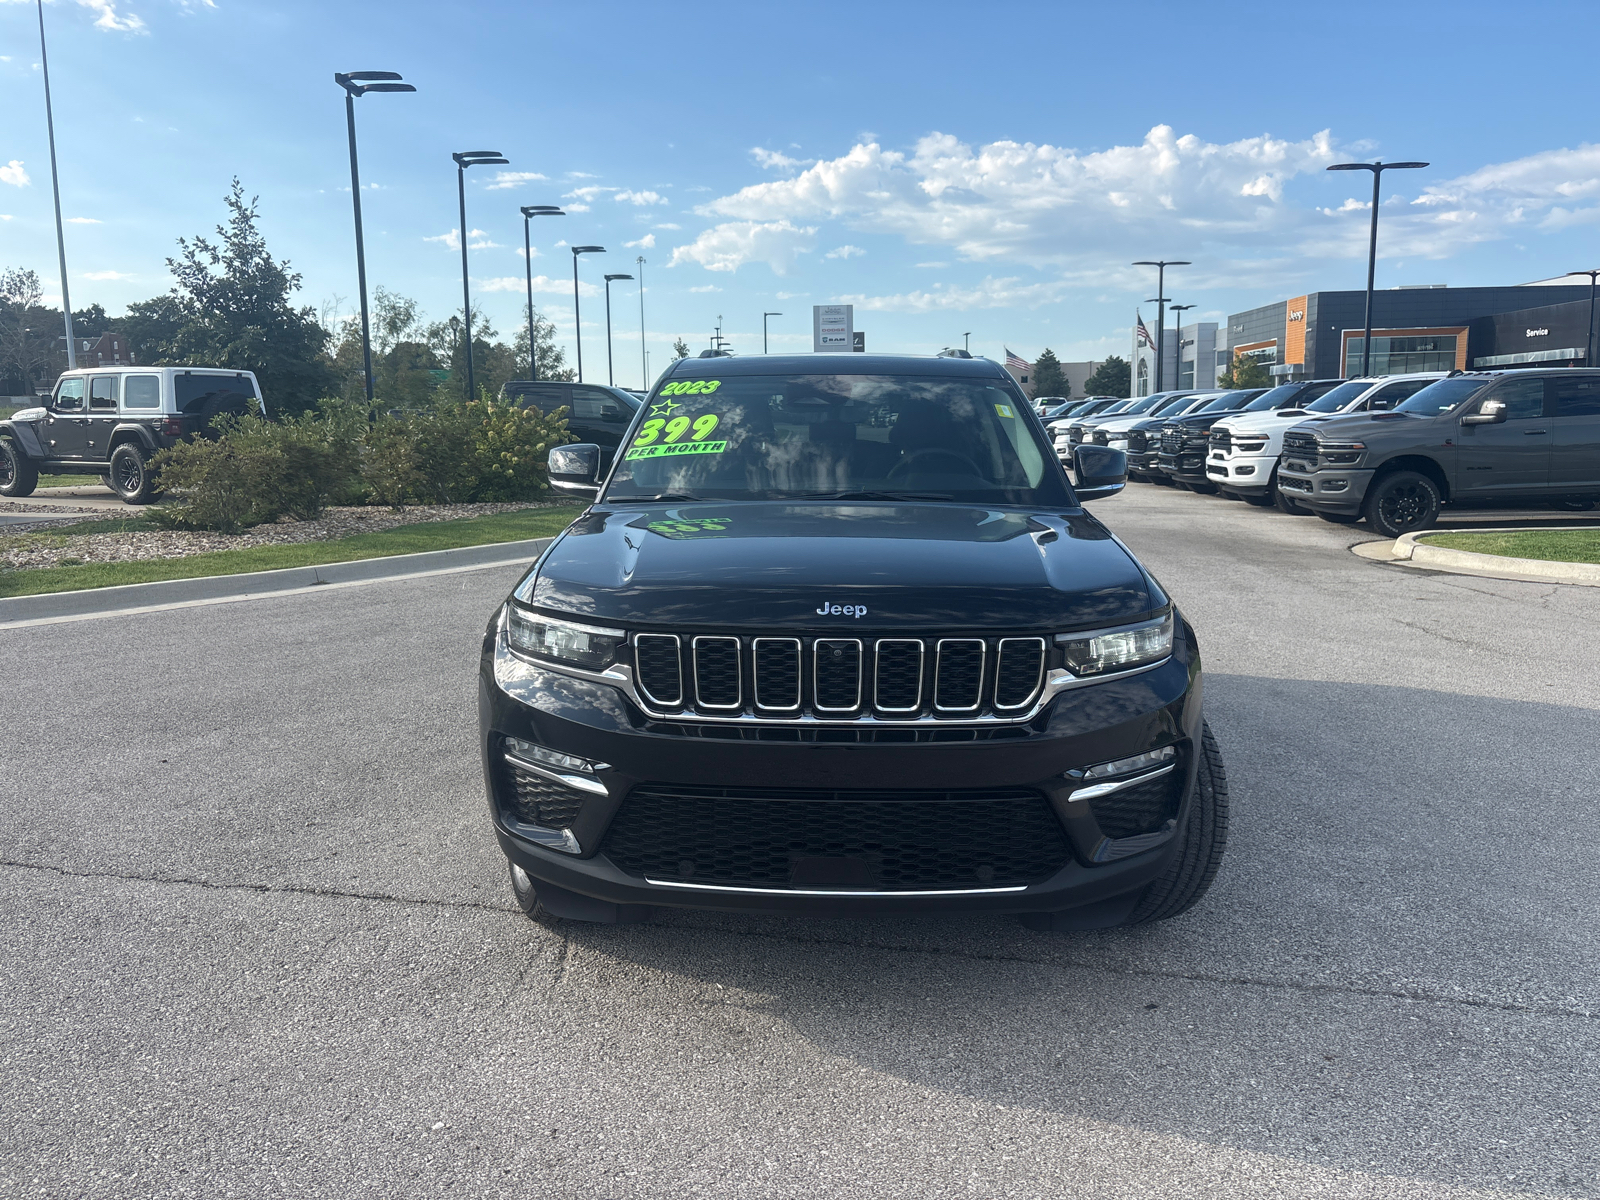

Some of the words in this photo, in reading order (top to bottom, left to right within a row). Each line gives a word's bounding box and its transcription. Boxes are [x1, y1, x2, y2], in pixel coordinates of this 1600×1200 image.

[1289, 310, 1303, 322] Jeep
[1526, 328, 1549, 338] Service
[660, 380, 721, 396] 2023
[634, 414, 719, 446] 399
[627, 447, 659, 459] PER
[663, 442, 725, 455] MONTH
[816, 601, 868, 619] Jeep
